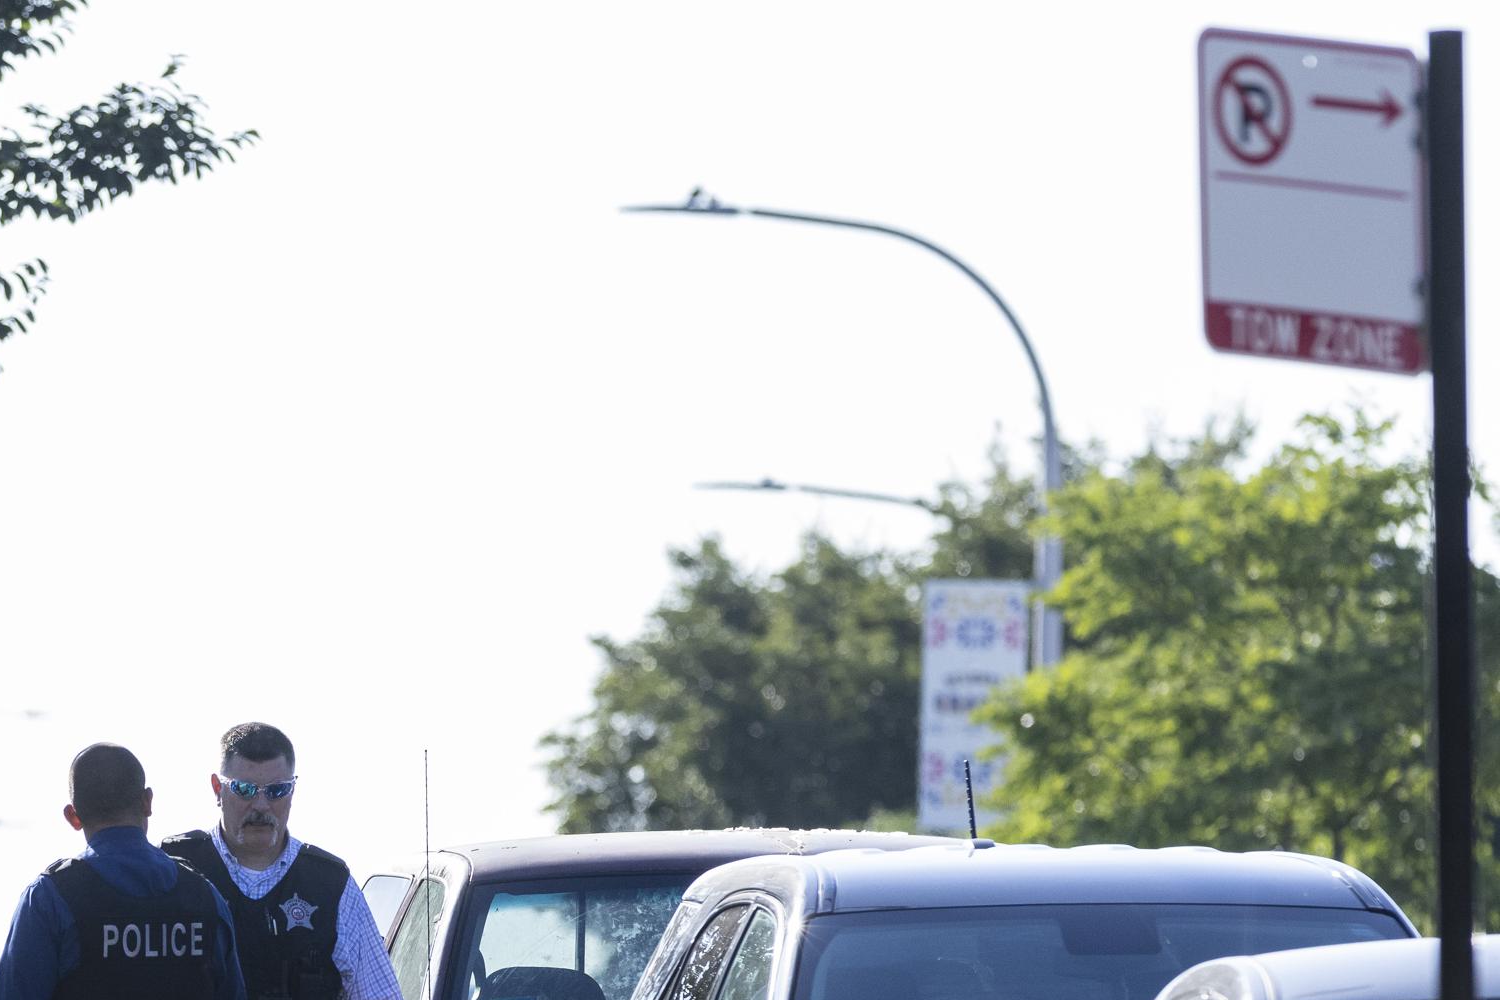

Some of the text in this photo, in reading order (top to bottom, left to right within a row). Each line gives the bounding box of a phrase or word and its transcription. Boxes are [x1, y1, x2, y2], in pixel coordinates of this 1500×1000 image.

[1227, 308, 1406, 370] TOW ZONE
[103, 922, 203, 958] POLICE
